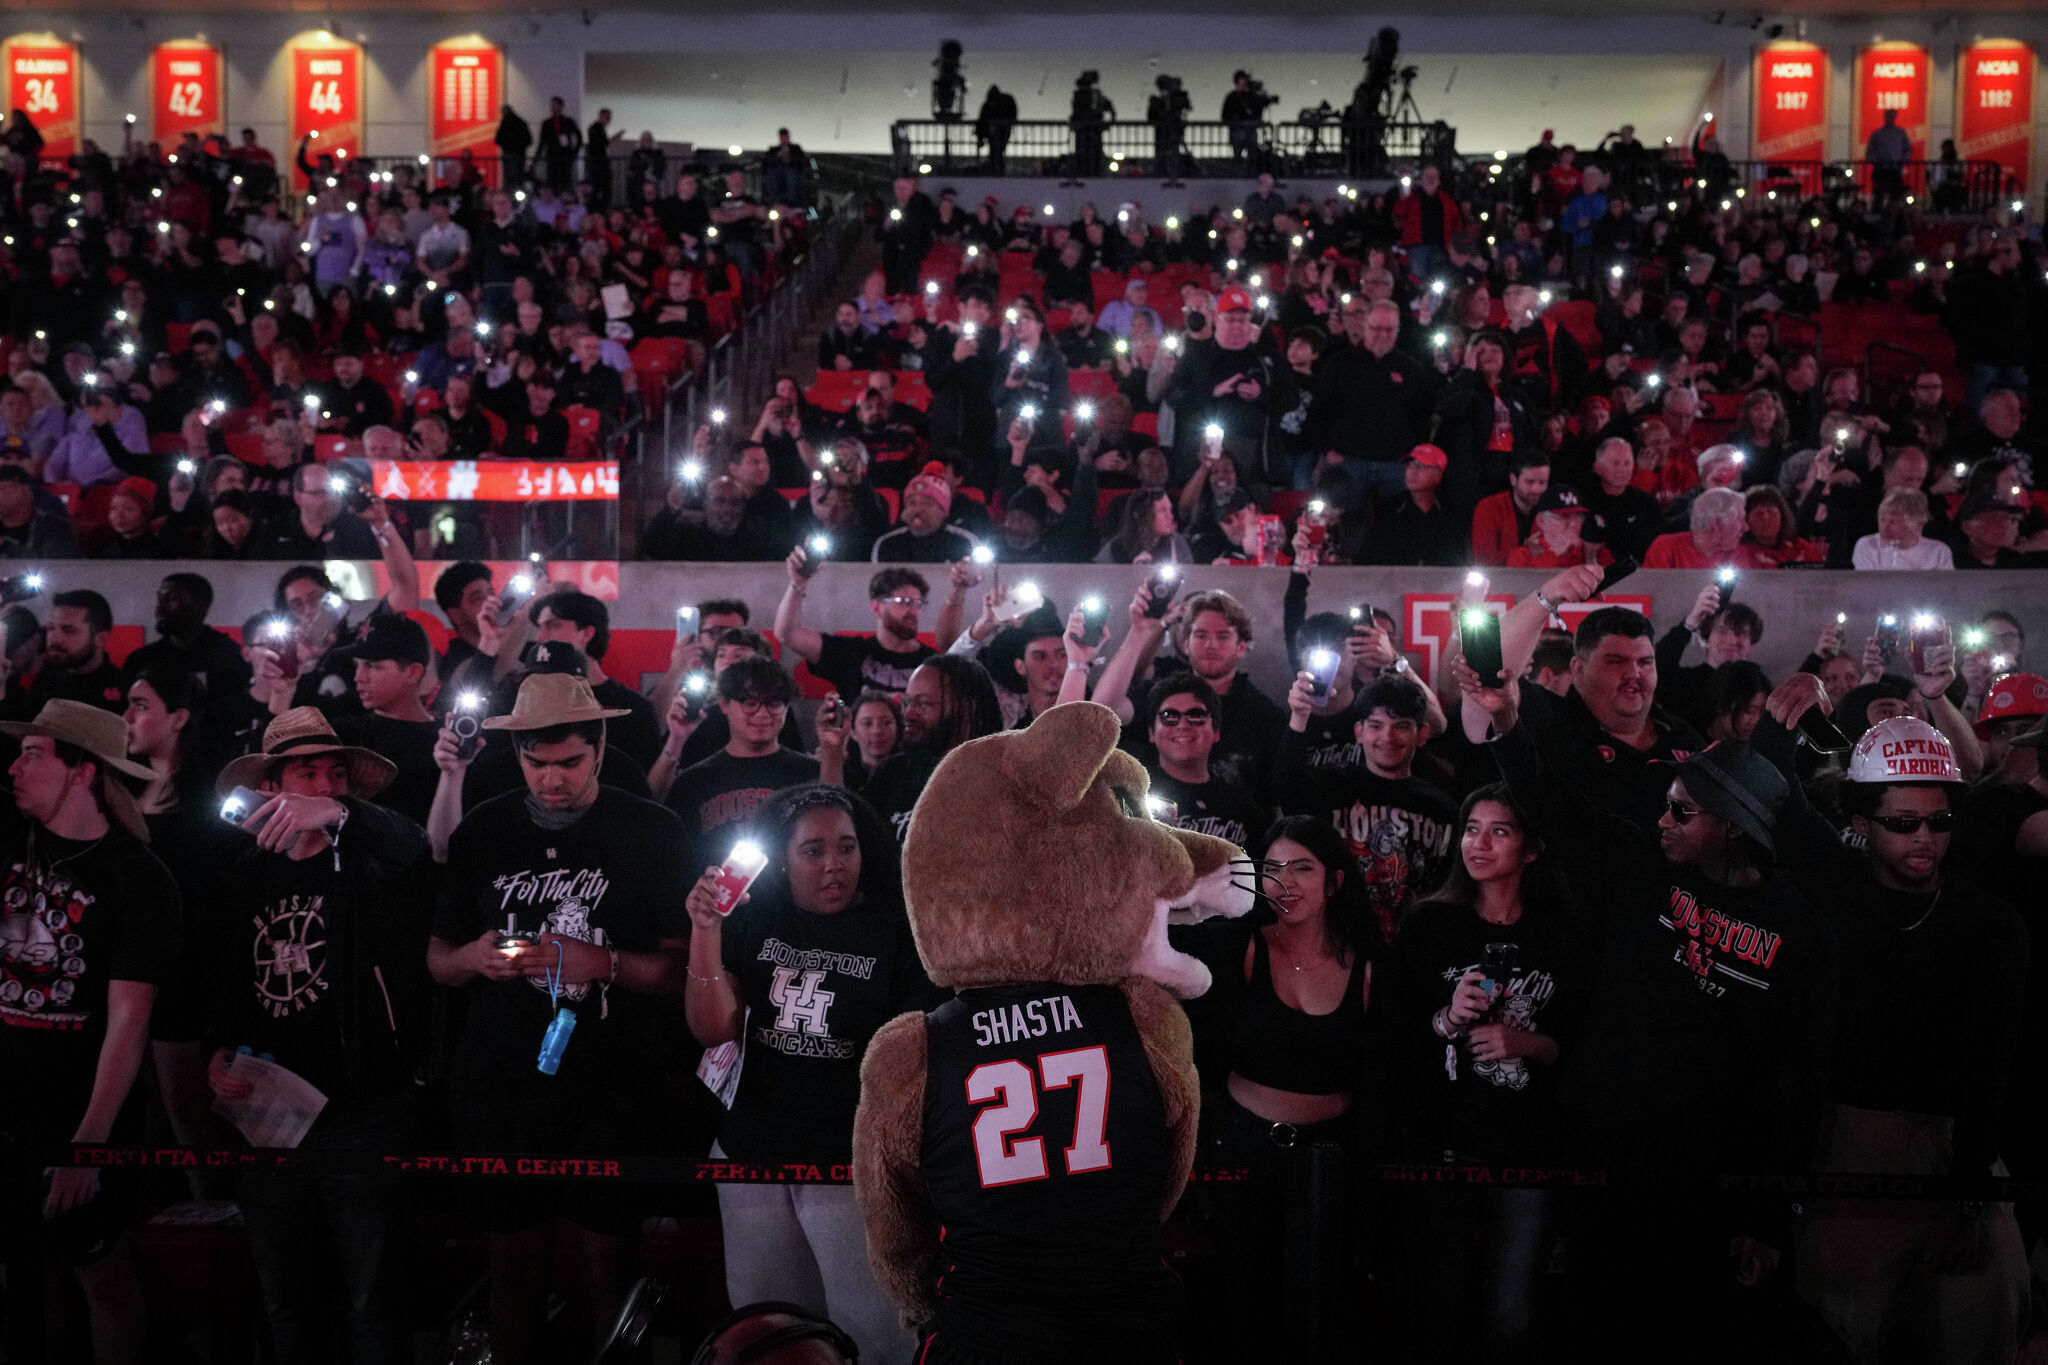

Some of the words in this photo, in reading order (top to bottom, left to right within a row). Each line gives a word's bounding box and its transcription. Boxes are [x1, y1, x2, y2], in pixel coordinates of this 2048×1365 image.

[25, 79, 59, 113] 34
[169, 81, 203, 116] 42
[309, 80, 342, 114] 44
[757, 937, 877, 980] HOUSTON
[769, 966, 836, 1038] UH
[972, 995, 1083, 1047] SHASTA
[751, 1026, 855, 1060] UGARS
[965, 1044, 1113, 1189] 27
[516, 1158, 621, 1177] CENTER
